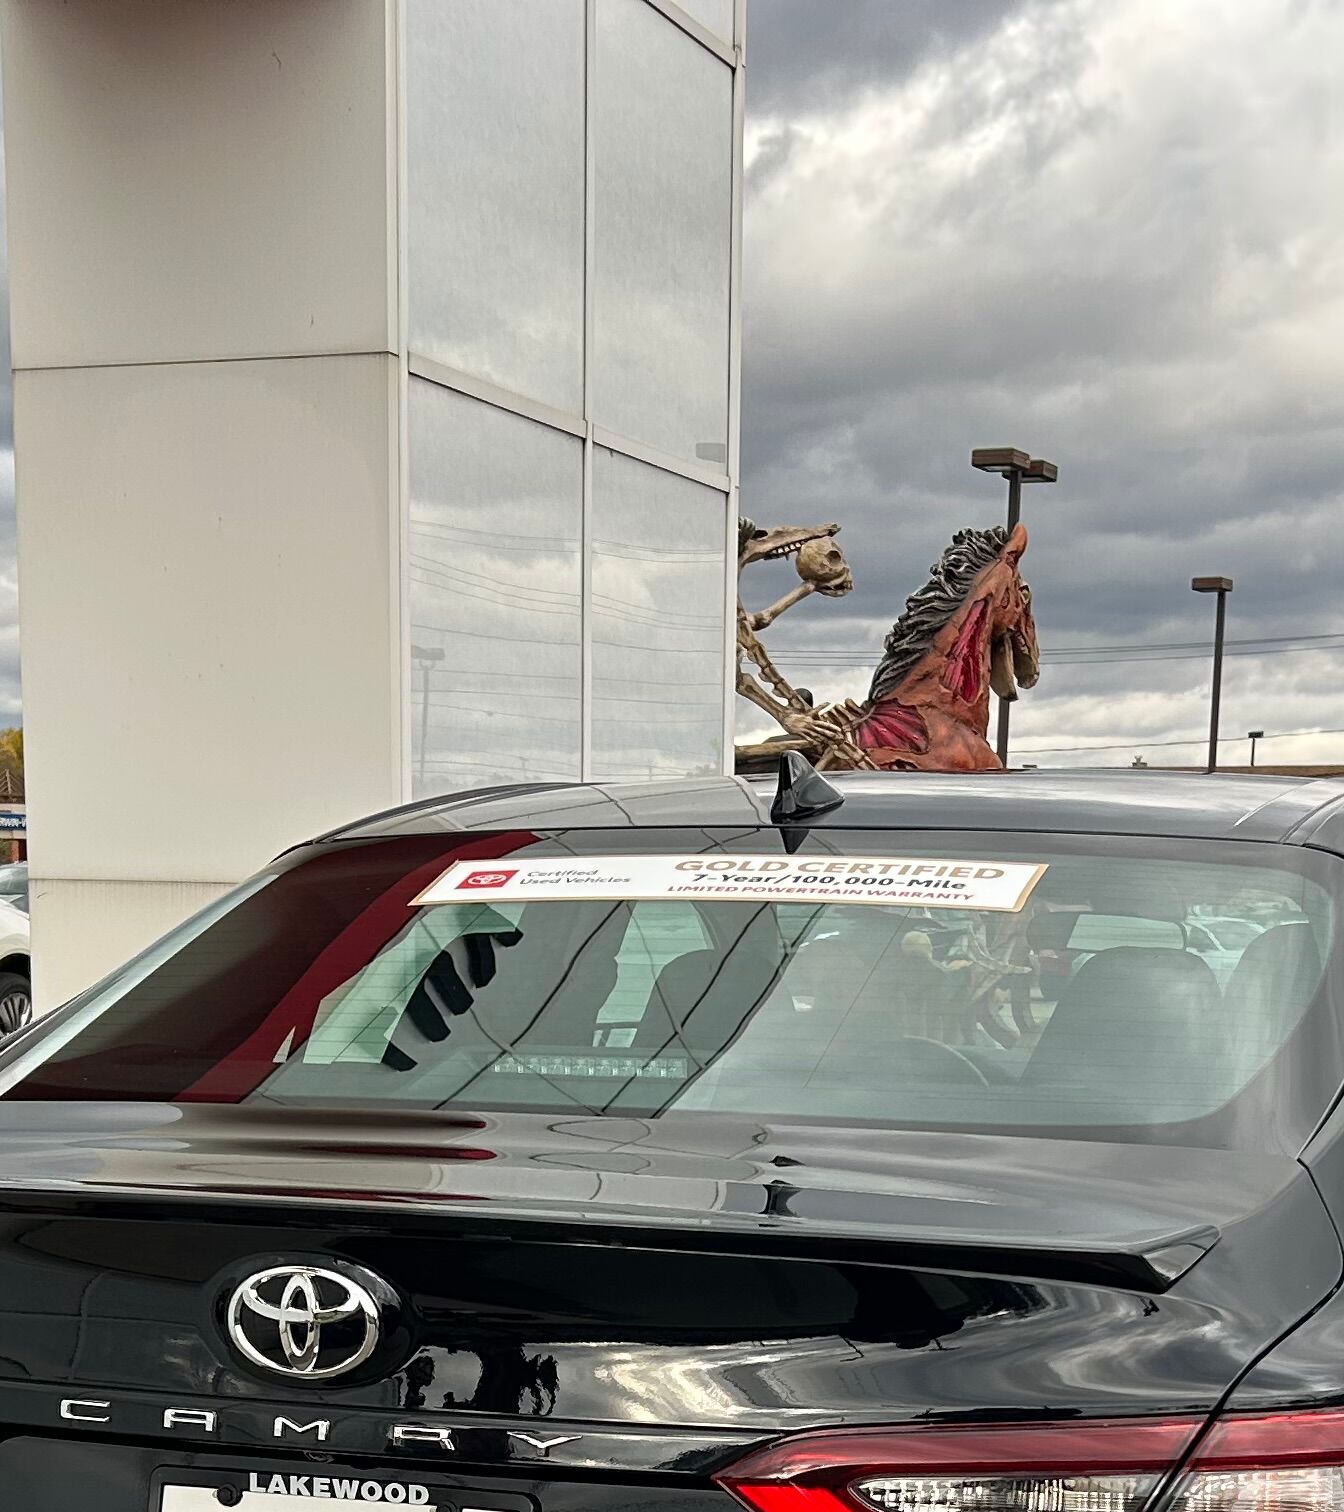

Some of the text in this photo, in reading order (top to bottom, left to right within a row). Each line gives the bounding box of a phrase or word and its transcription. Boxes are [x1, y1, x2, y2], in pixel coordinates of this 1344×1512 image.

[526, 869, 599, 878] Certified
[674, 859, 1005, 881] GOLD CERTIFIED
[519, 875, 632, 886] Used Vehicles
[692, 872, 966, 891] 7-Year/100,000-Mile
[667, 885, 976, 901] LIMITED POWERTRAIN WARRANTY
[59, 1398, 584, 1457] CAMRY
[248, 1471, 430, 1506] LAKEWOOD
